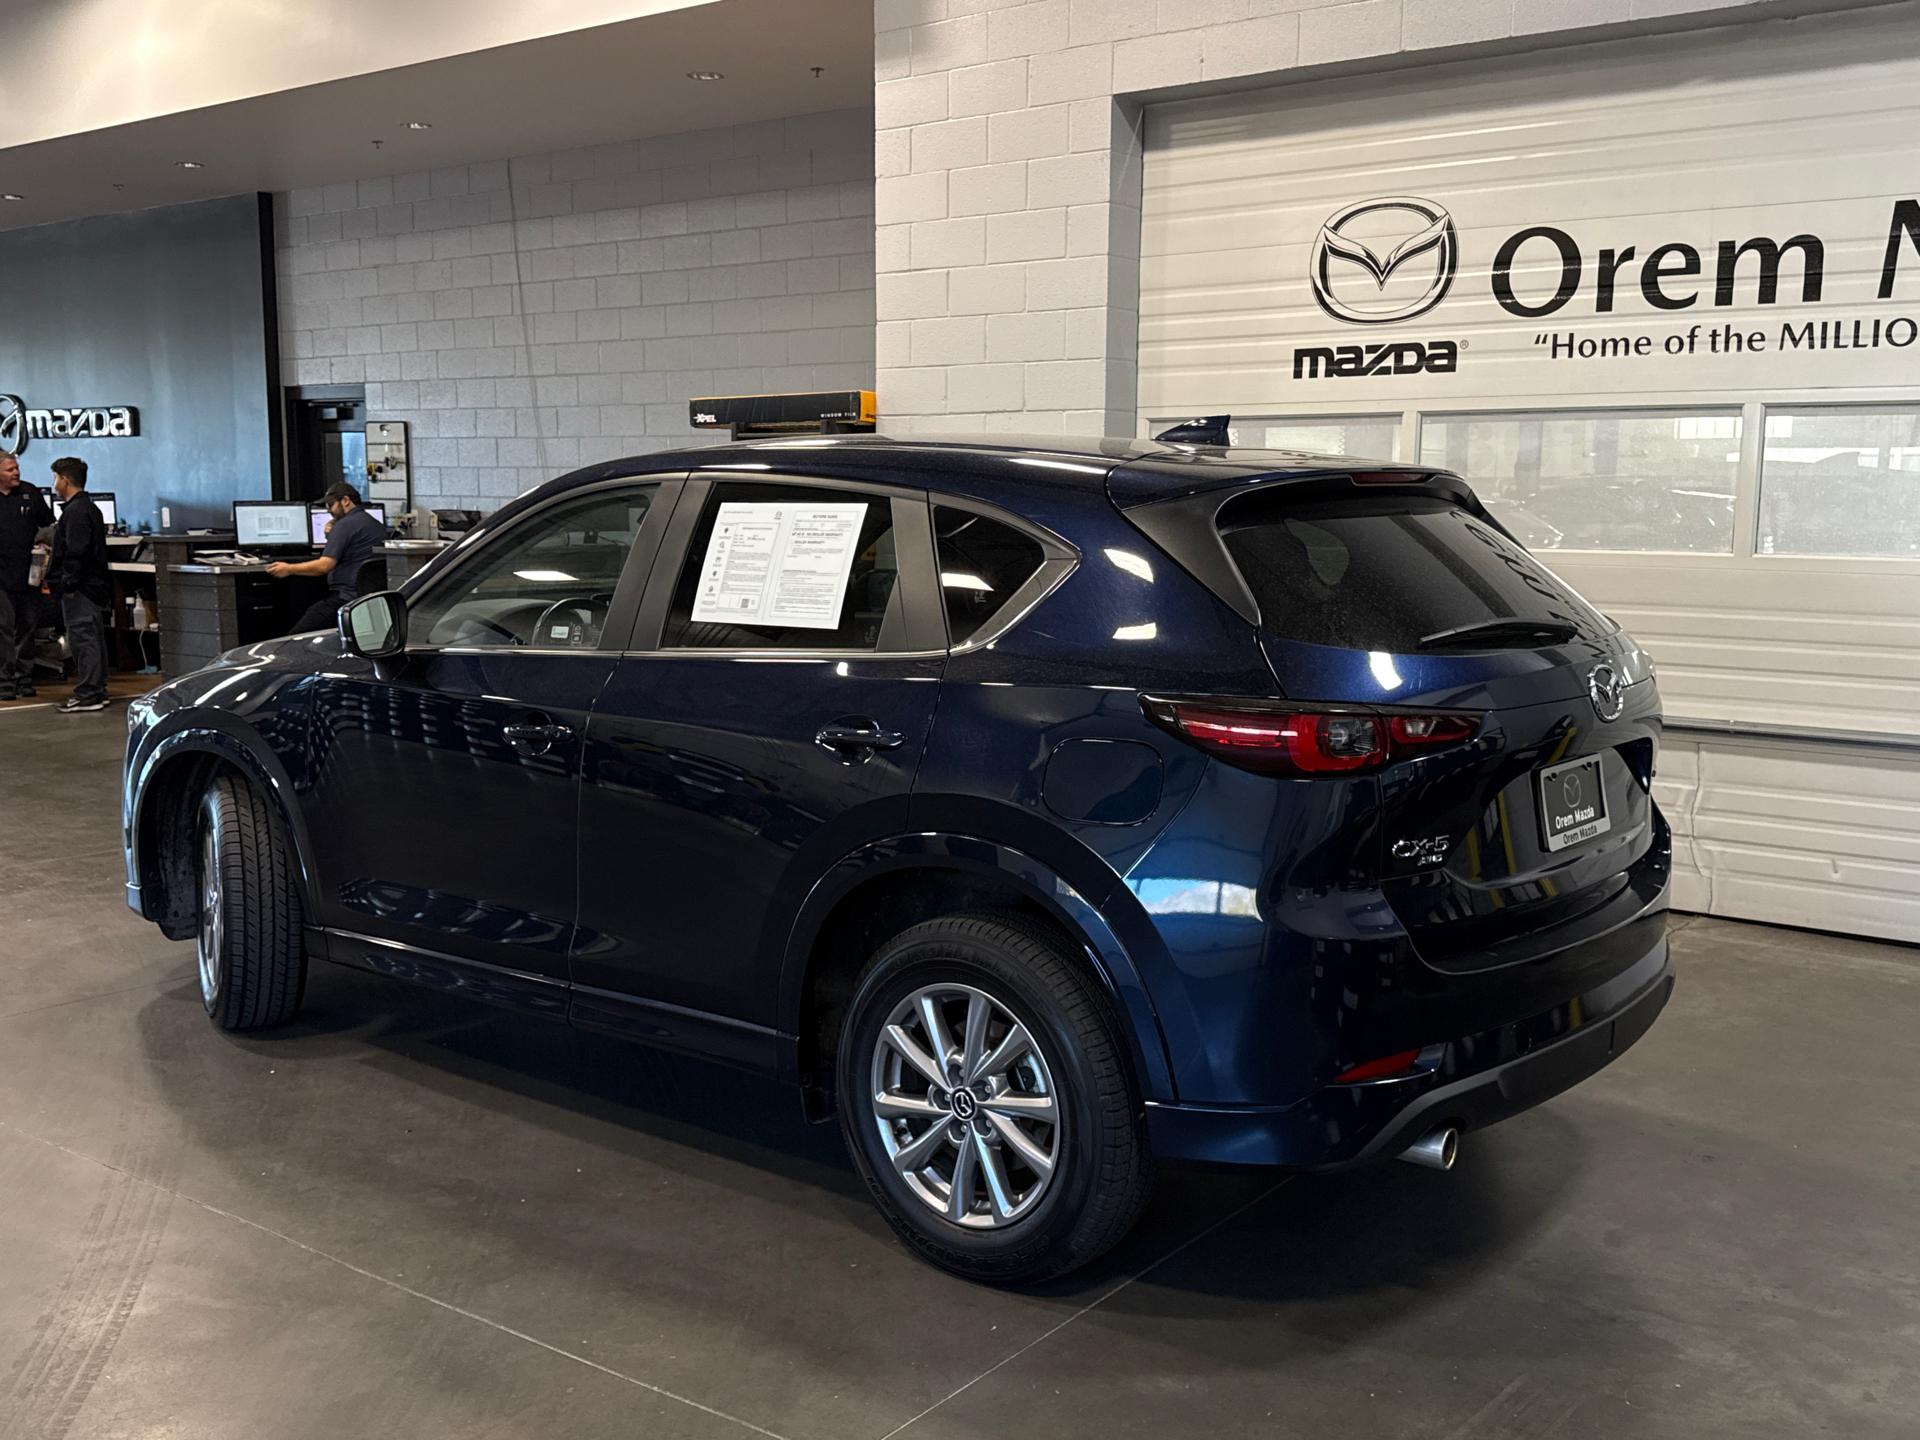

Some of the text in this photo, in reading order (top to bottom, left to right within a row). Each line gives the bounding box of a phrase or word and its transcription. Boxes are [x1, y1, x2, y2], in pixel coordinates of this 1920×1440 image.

[1491, 226, 1824, 317] Orem
[1664, 325, 1702, 354] of
[1709, 324, 1766, 353] the
[1779, 318, 1918, 351] MILLIO
[1555, 805, 1595, 829] Orem Mazda
[1391, 834, 1450, 858] CX-5
[1563, 824, 1598, 845] Orem Mazda
